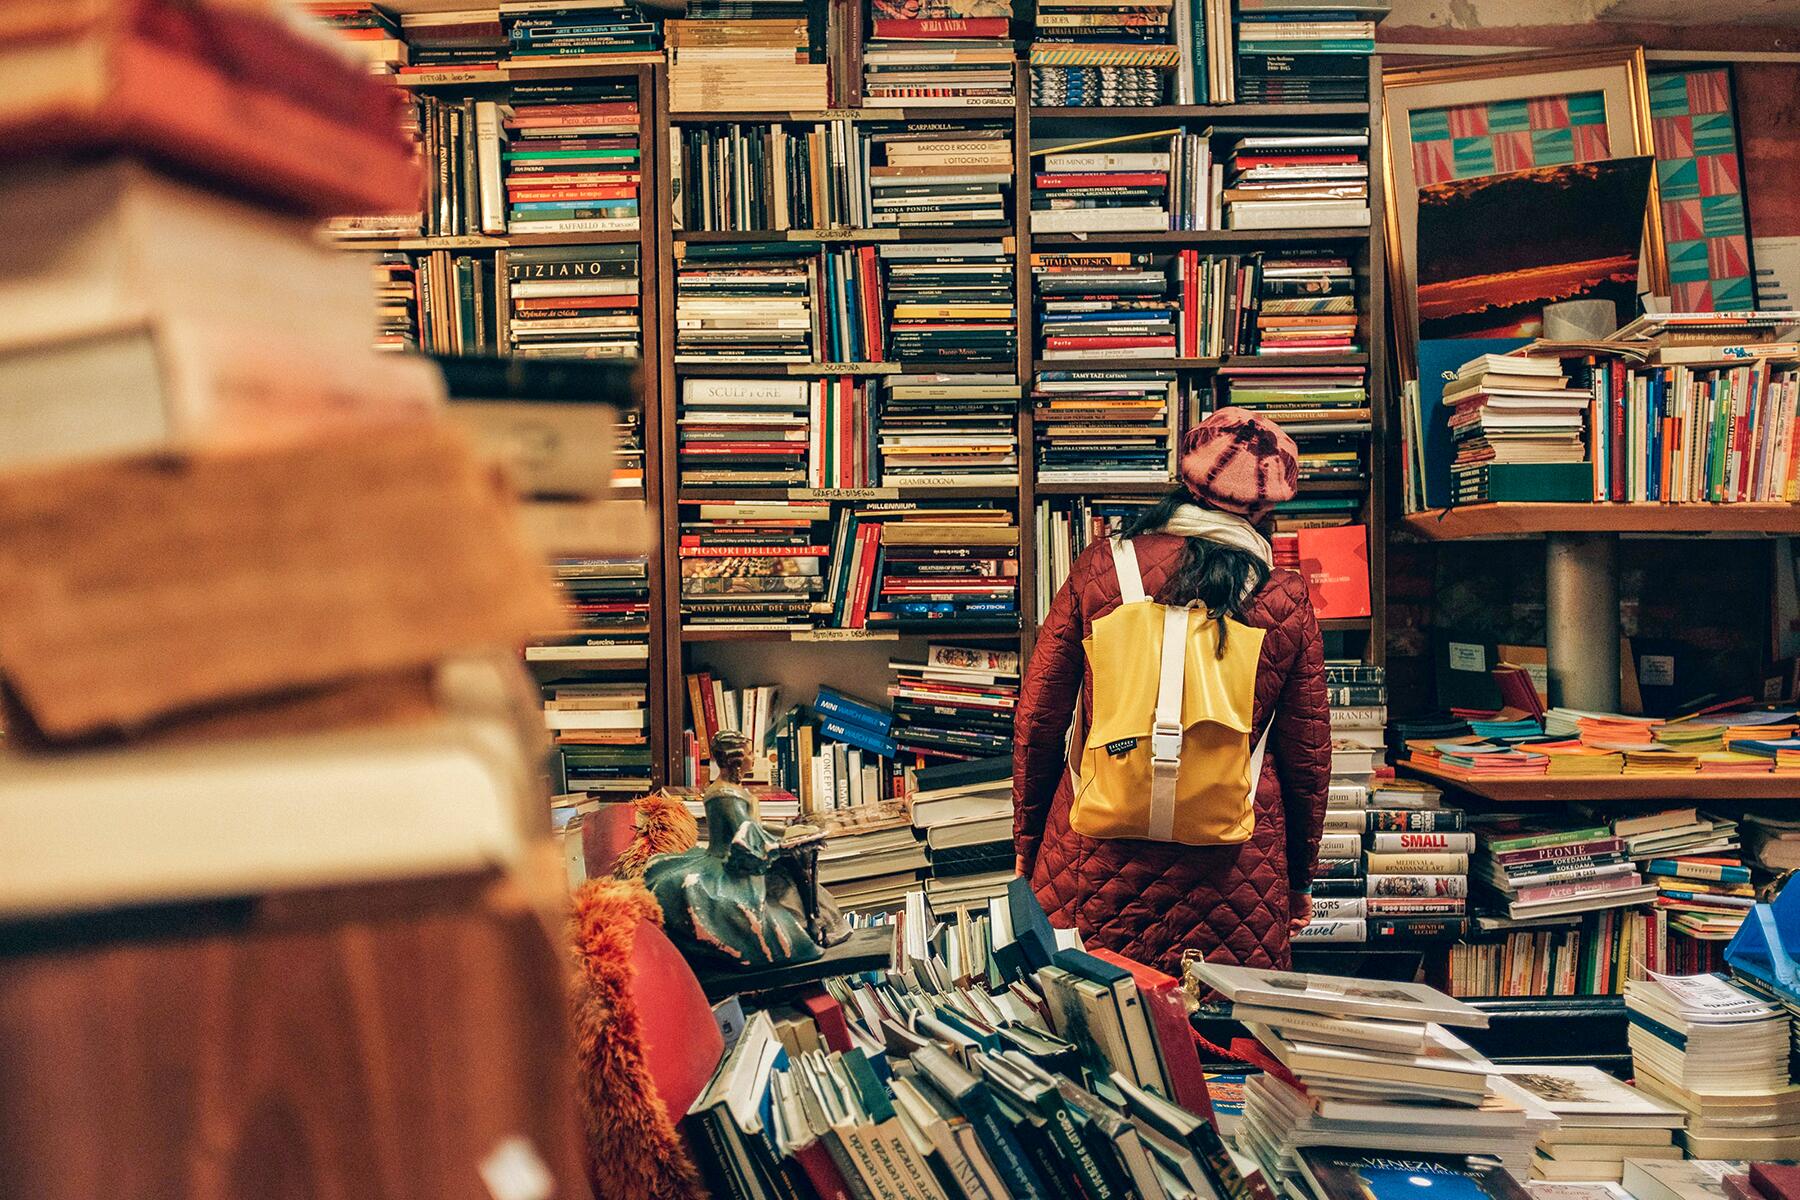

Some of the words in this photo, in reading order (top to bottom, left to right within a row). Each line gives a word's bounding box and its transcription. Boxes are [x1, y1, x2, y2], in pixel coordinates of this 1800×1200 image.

[819, 110, 861, 118] SCULTURA
[918, 144, 949, 152] BAROCCO
[1066, 158, 1094, 166] MINORI
[816, 230, 853, 238] SCULTURA
[1044, 257, 1078, 266] ITALIAN
[1080, 257, 1112, 266] DESIGN
[512, 262, 601, 278] TIZIANO
[1723, 346, 1745, 354] CASA
[824, 364, 860, 372] SCULTURA
[708, 386, 782, 398] SCULPTURE
[899, 478, 955, 486] GIAMBOLOGNA
[866, 502, 916, 510] MILLENNIUM
[743, 546, 782, 555] DELLO
[784, 546, 818, 554] STILE
[690, 604, 724, 612] MAESTRI
[728, 604, 764, 612] ITALIANI
[820, 700, 838, 712] MINI
[827, 723, 844, 734] MINI
[823, 752, 833, 790] CONCEPT
[840, 779, 848, 808] BMW
[1324, 820, 1348, 829] Leonar
[1410, 814, 1421, 830] 100
[1400, 834, 1448, 848] SMALL
[1539, 845, 1586, 859] PEONIE
[1553, 856, 1592, 866] KOKEDAMA
[1556, 862, 1594, 872] KOKEDAMA
[1548, 886, 1572, 899] Arte
[1312, 901, 1340, 910] RIORS
[1398, 904, 1424, 912] RECORD
[1424, 904, 1449, 912] COVERS
[846, 1133, 878, 1178] venezia
[1076, 1146, 1087, 1156] A
[868, 1137, 900, 1183] venezia
[888, 1136, 921, 1182] venezia
[1362, 1156, 1448, 1173] VENEZIA
[1080, 1153, 1104, 1188] VENEZIA
[1098, 1184, 1111, 1200] DA
